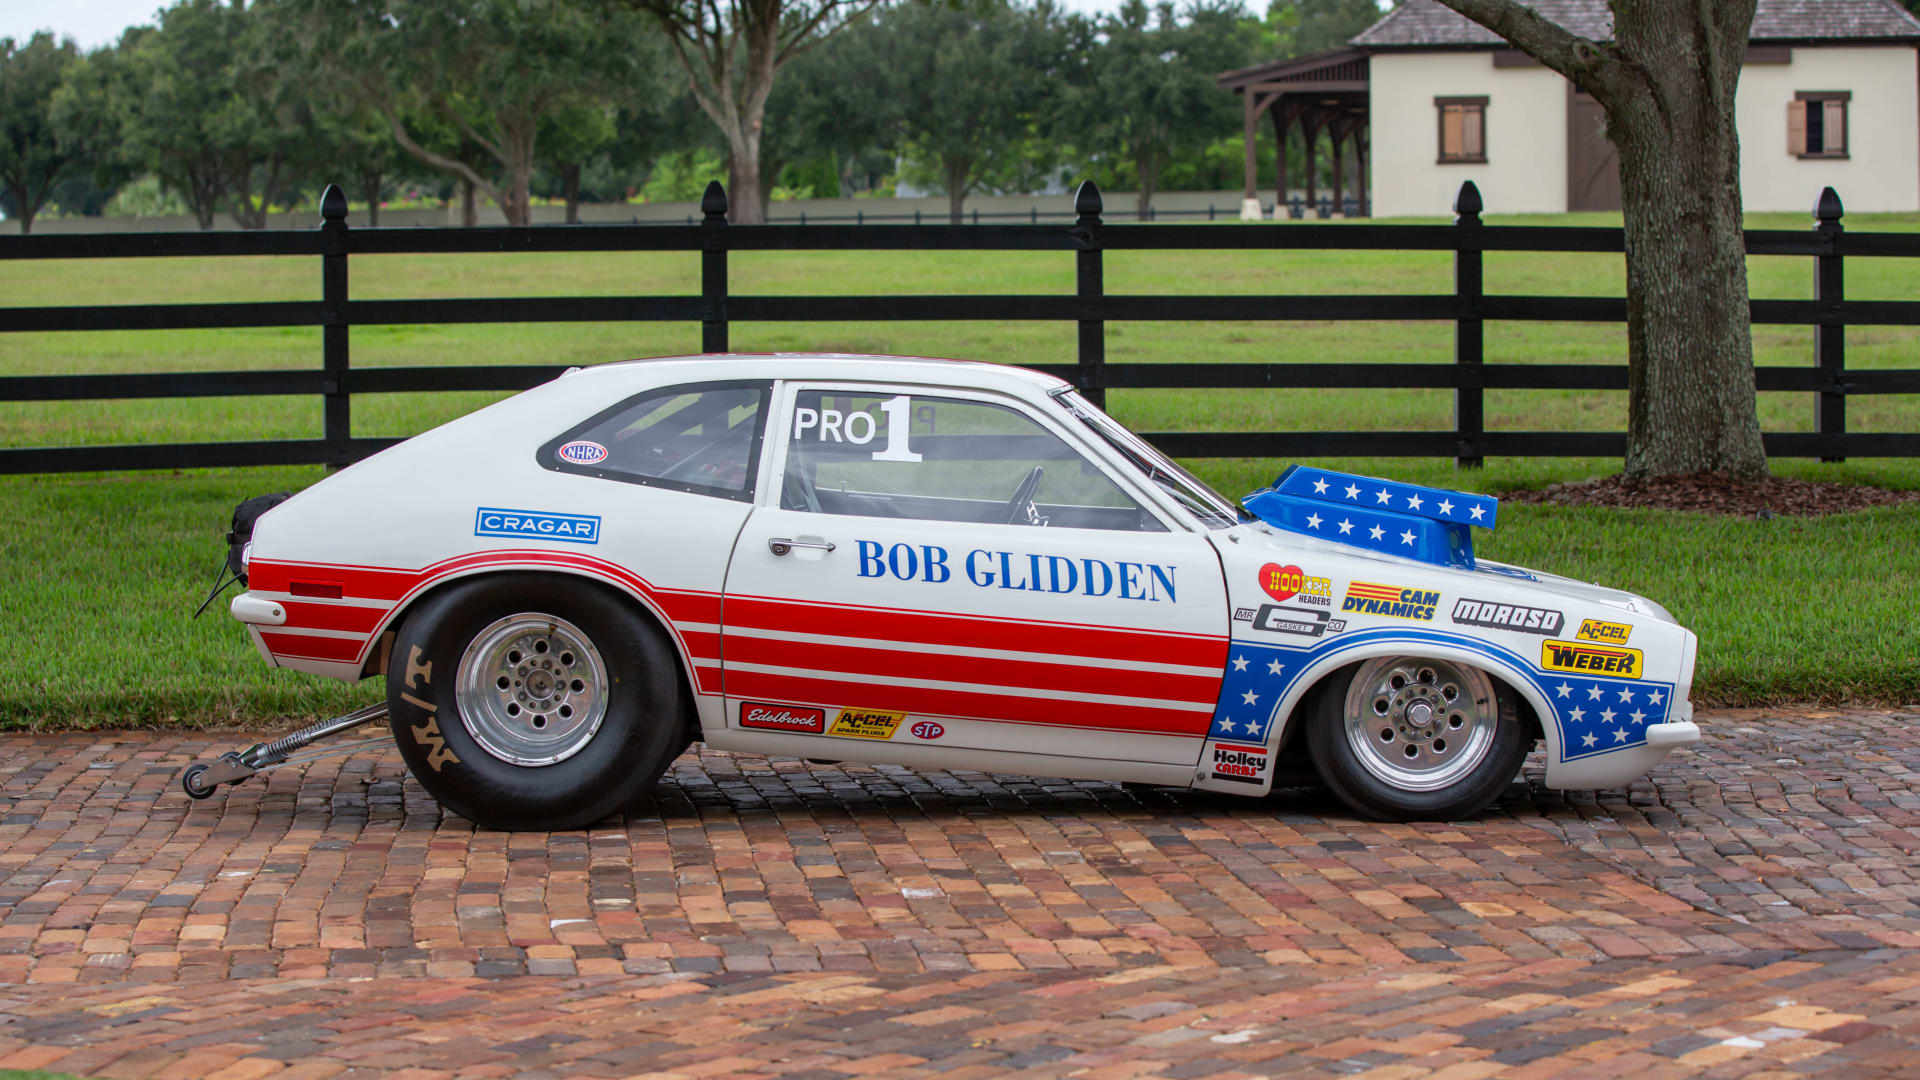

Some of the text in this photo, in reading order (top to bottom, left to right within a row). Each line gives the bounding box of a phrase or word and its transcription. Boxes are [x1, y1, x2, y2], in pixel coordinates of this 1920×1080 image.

[794, 408, 876, 444] PRO
[872, 396, 922, 462] 1
[568, 446, 601, 459] NHRA
[484, 516, 592, 536] CRAGAR
[855, 540, 1177, 604] BOB GLIDDEN
[1269, 571, 1332, 597] HOOKER
[1298, 594, 1331, 606] HEADERS
[1400, 589, 1440, 606] CAM
[1342, 596, 1435, 620] DYNAMICS
[1452, 598, 1563, 634] MOROSO
[1276, 622, 1308, 632] GASKET
[1580, 622, 1627, 640] ACCEL
[747, 708, 817, 727] Edelbrock
[840, 712, 894, 728] ACCEL
[914, 723, 941, 738] STP
[1213, 750, 1267, 771] Holley
